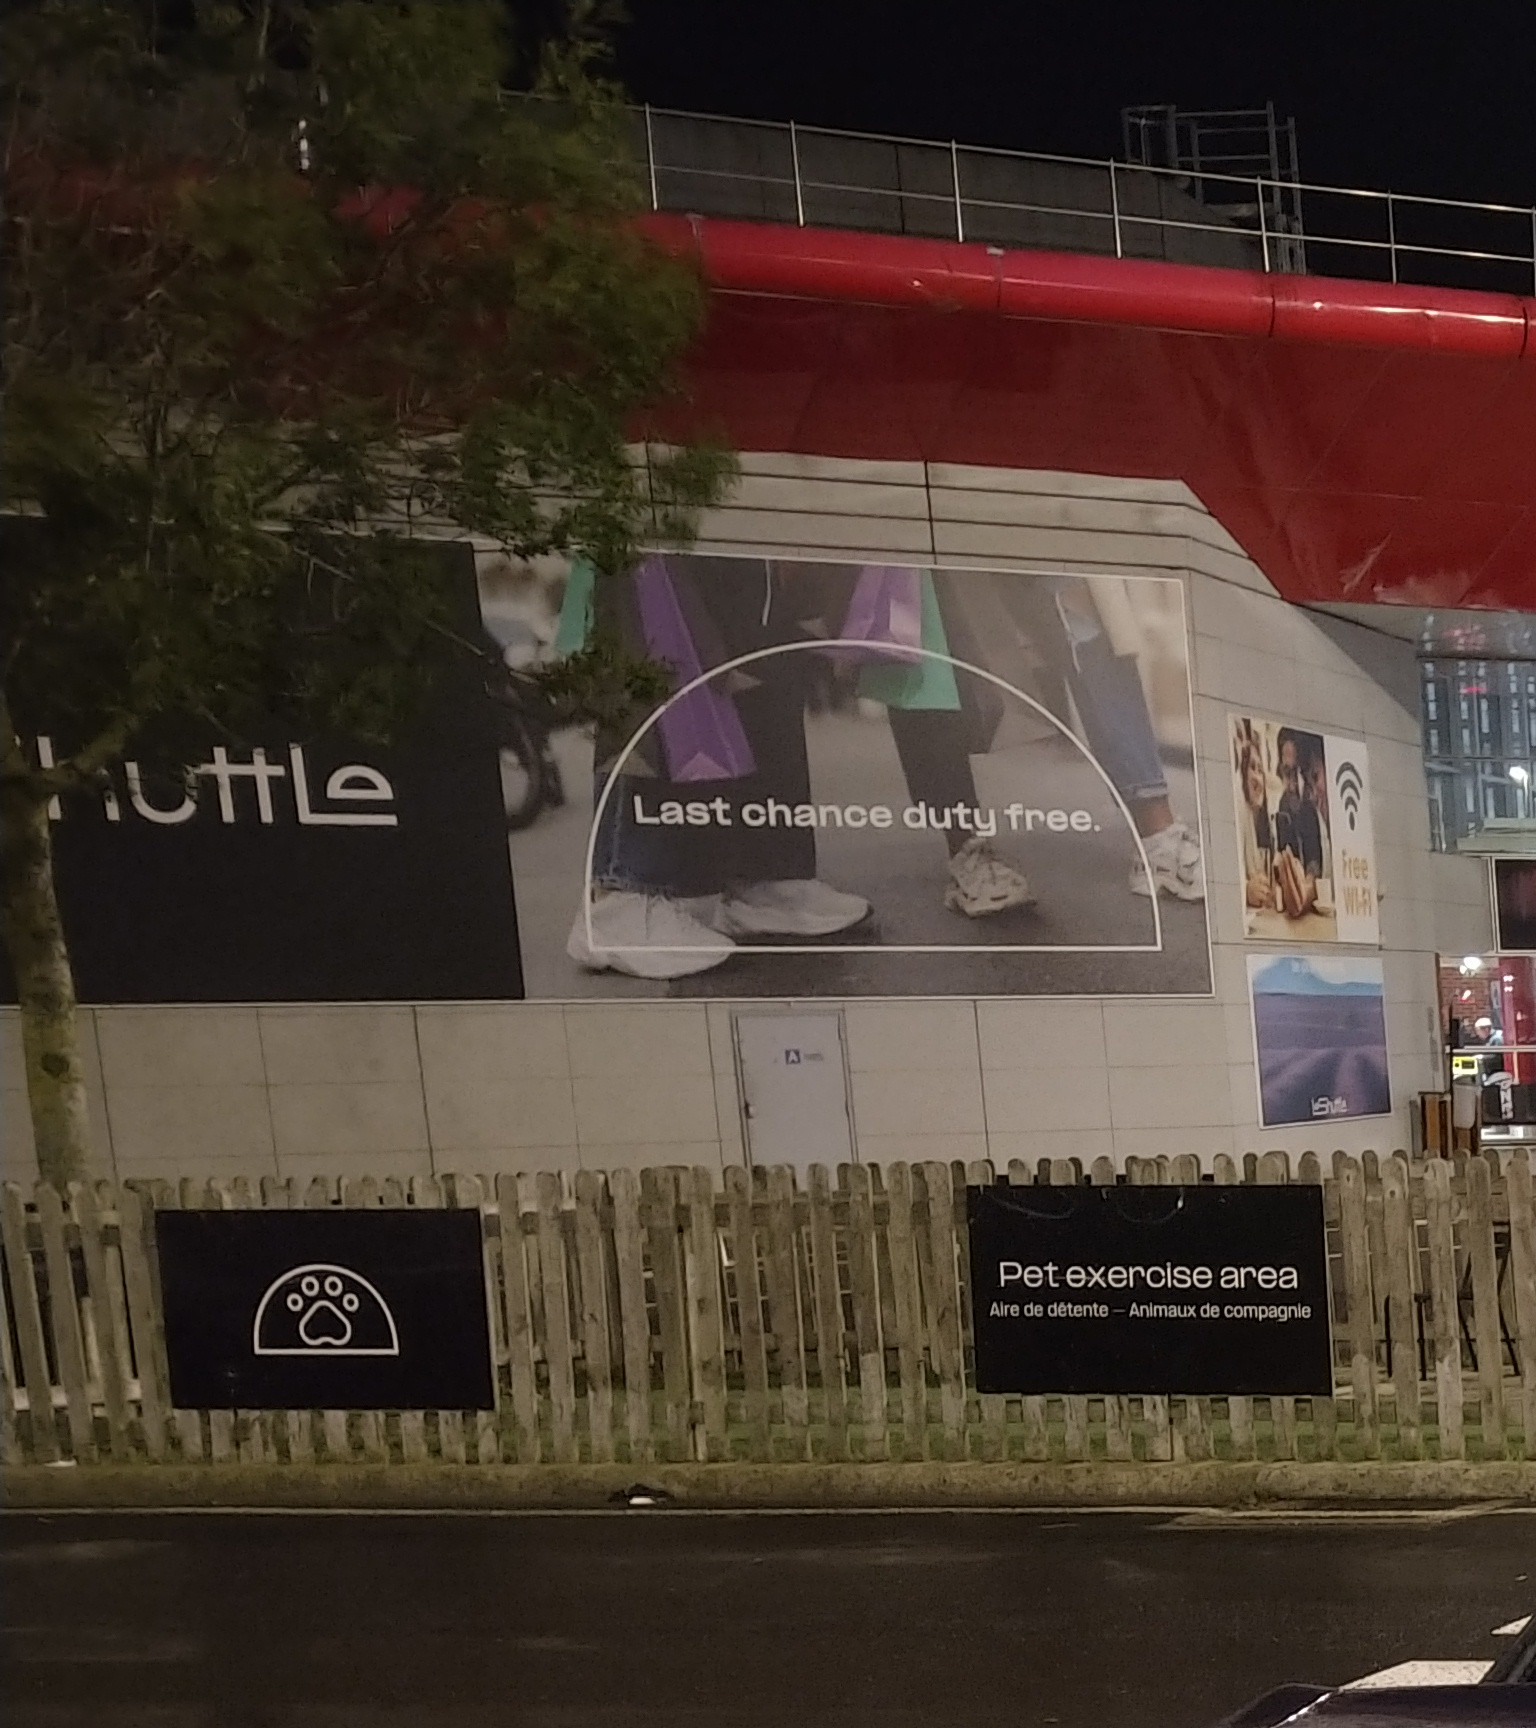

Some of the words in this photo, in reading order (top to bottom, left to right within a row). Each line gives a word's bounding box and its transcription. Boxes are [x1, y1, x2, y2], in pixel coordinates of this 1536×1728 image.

[633, 795, 732, 826] Last
[741, 798, 893, 828] chance
[903, 800, 997, 836] duty
[1004, 802, 1101, 832] free.
[999, 1261, 1058, 1288] Pet
[1066, 1261, 1212, 1288] exercise
[1220, 1265, 1298, 1289] area
[989, 1302, 1020, 1318] Aire
[1023, 1303, 1044, 1318] de
[1047, 1302, 1109, 1318] détente
[1128, 1302, 1197, 1318] Animaux
[1200, 1303, 1220, 1319] de
[1224, 1302, 1312, 1323] compagnie
